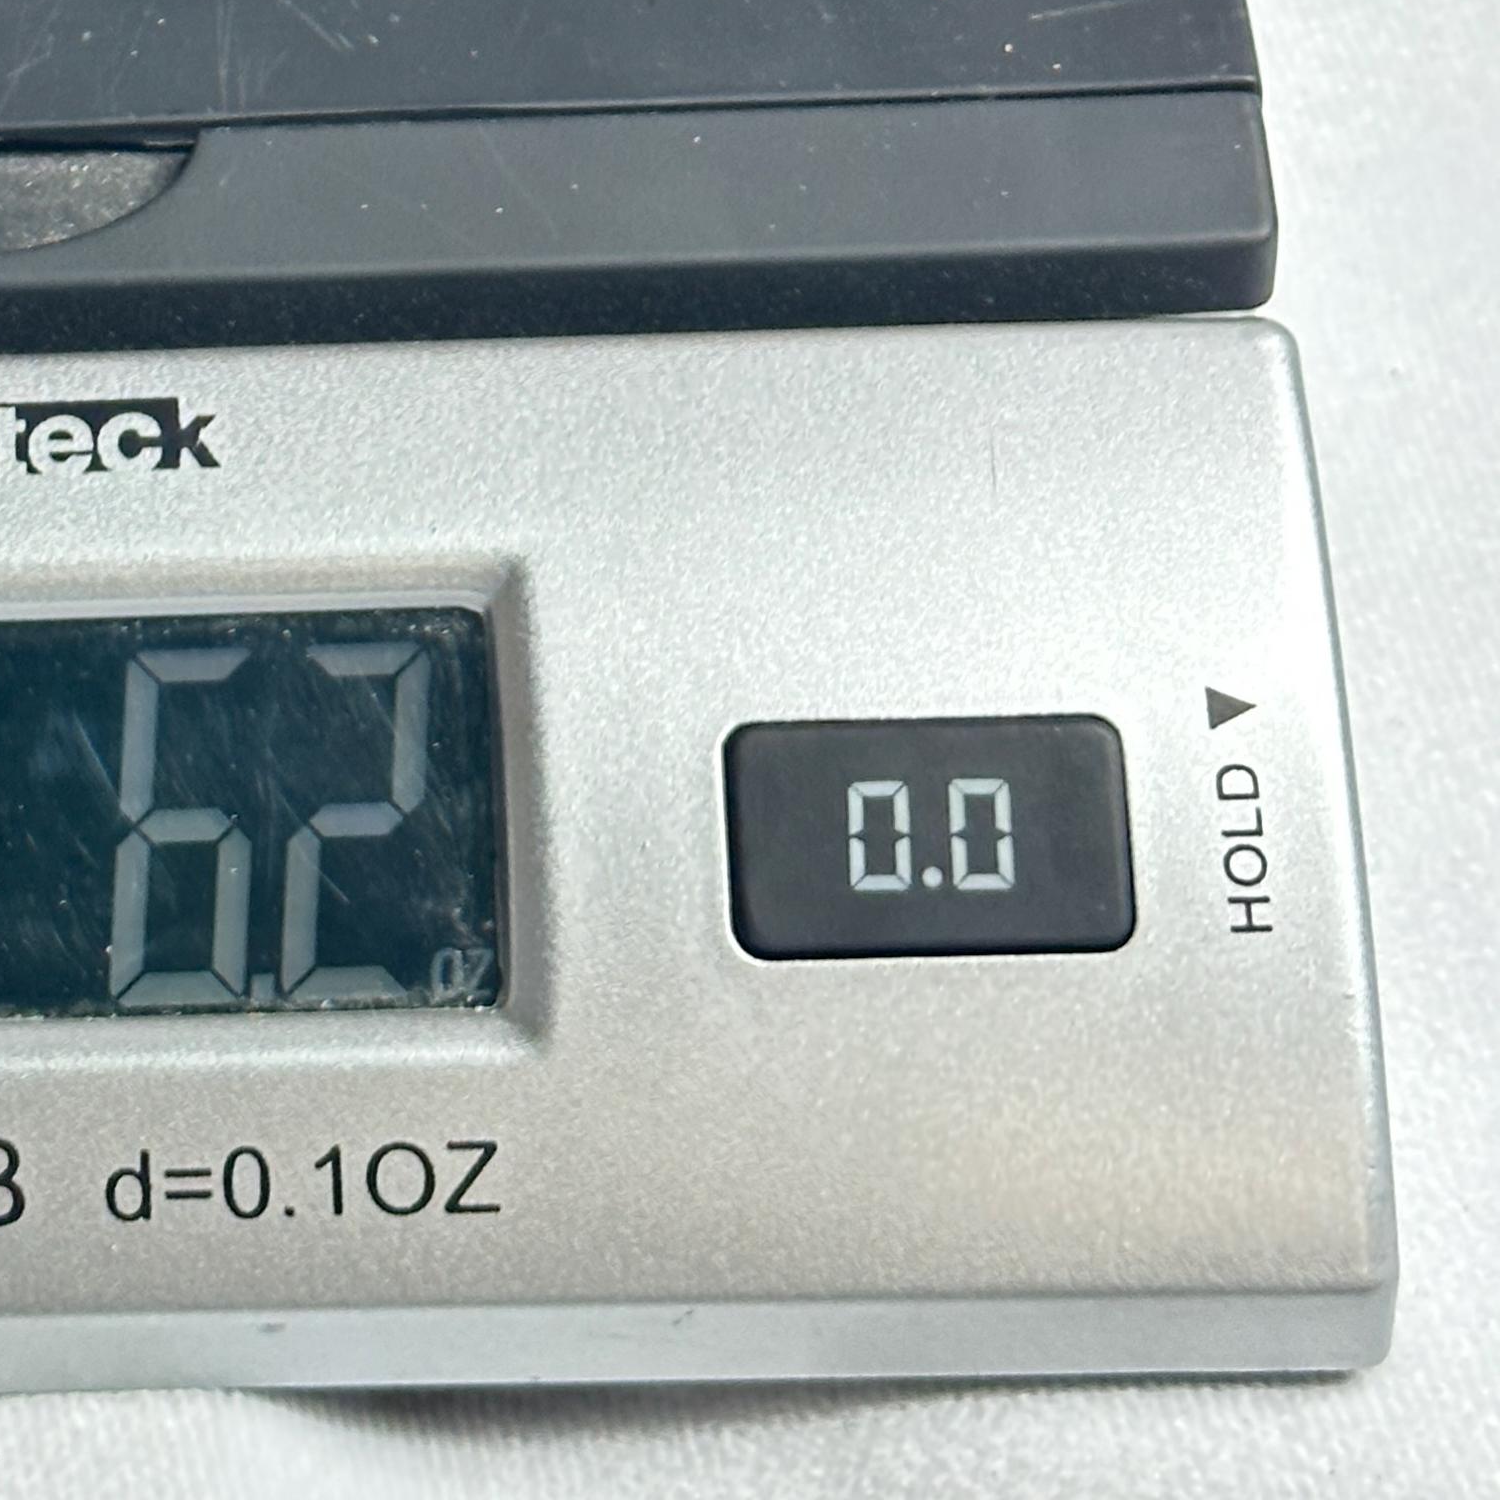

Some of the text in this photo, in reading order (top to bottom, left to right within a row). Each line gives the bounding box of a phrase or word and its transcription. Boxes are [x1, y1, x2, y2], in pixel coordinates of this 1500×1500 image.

[109, 641, 431, 1008] 6.2
[847, 778, 1015, 891] 0.0
[1216, 763, 1273, 934] HOLD
[103, 1140, 503, 1223] d=0.1OZ
